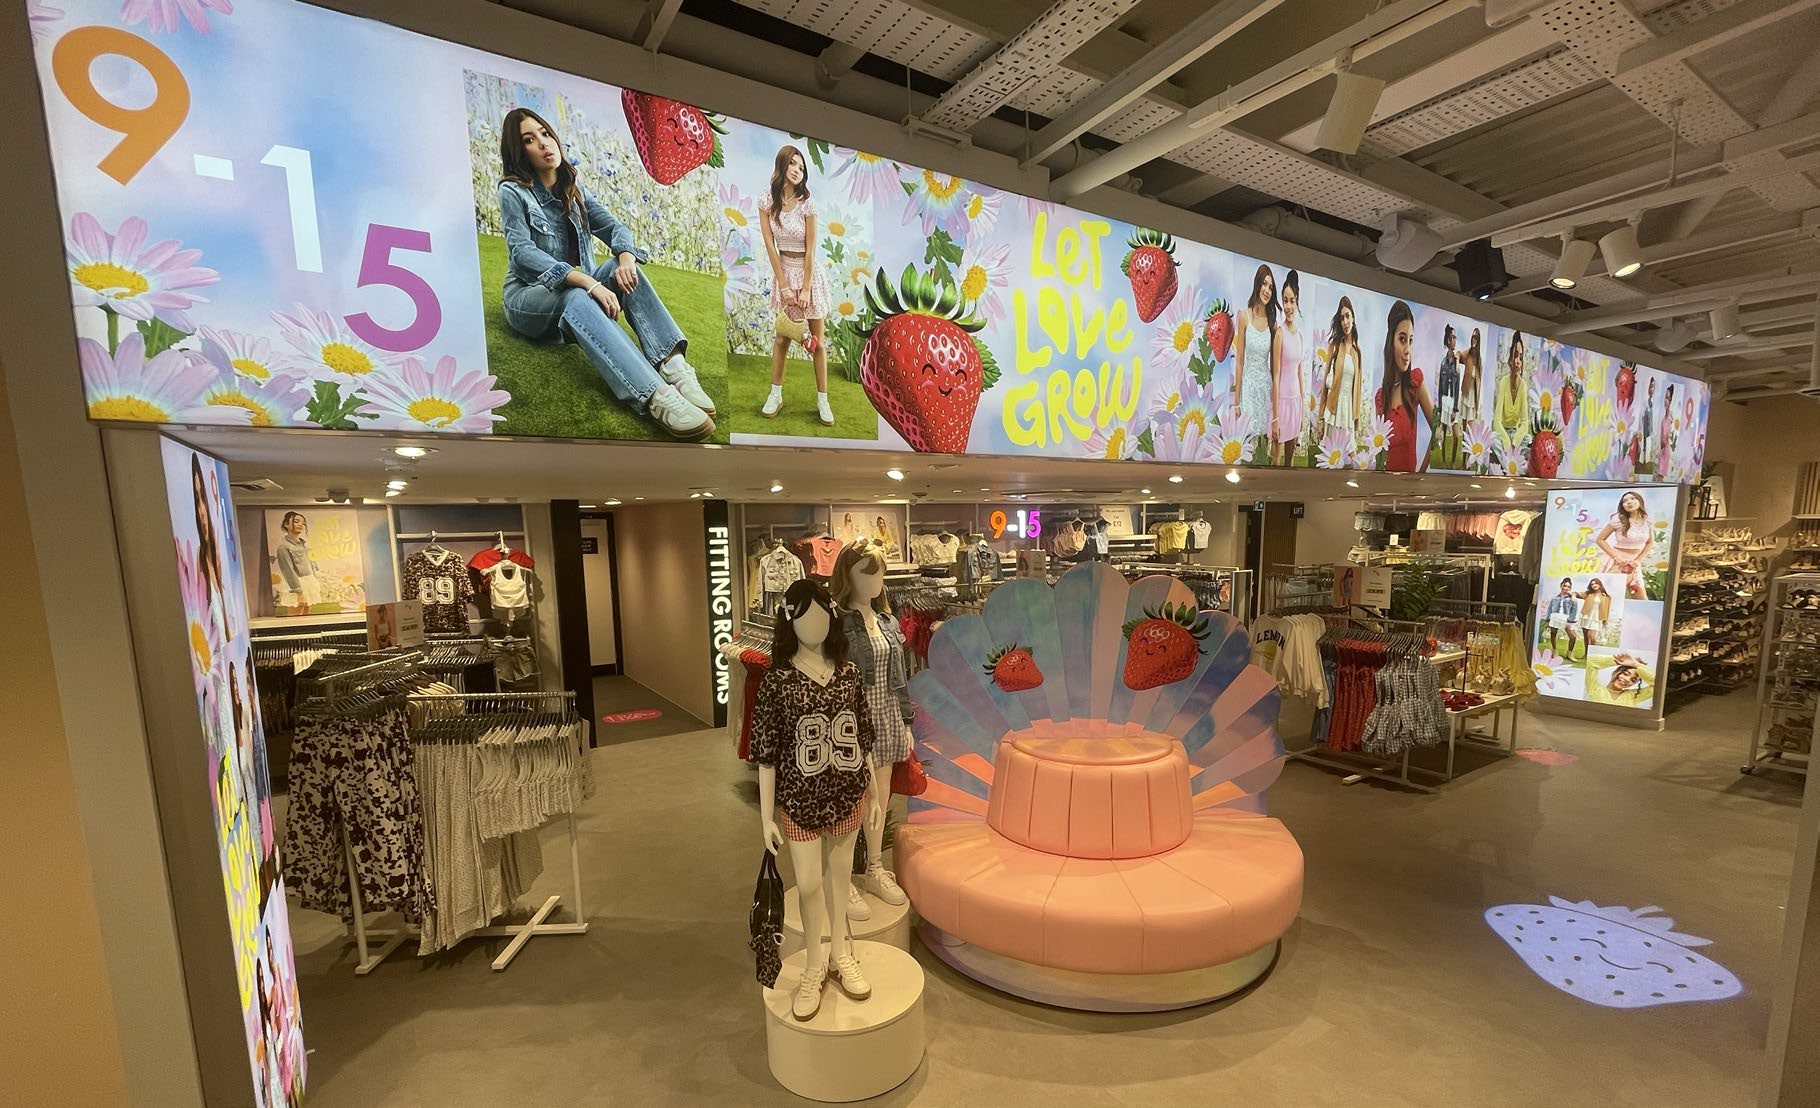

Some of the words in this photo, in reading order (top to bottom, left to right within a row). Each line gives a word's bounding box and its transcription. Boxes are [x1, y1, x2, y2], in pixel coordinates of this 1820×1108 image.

[51, 25, 443, 353] 9-15
[1002, 356, 1142, 448] GROW
[989, 509, 1042, 539] 9-15
[418, 577, 455, 605] 89
[708, 526, 732, 616] FITTING
[795, 709, 864, 777] 89
